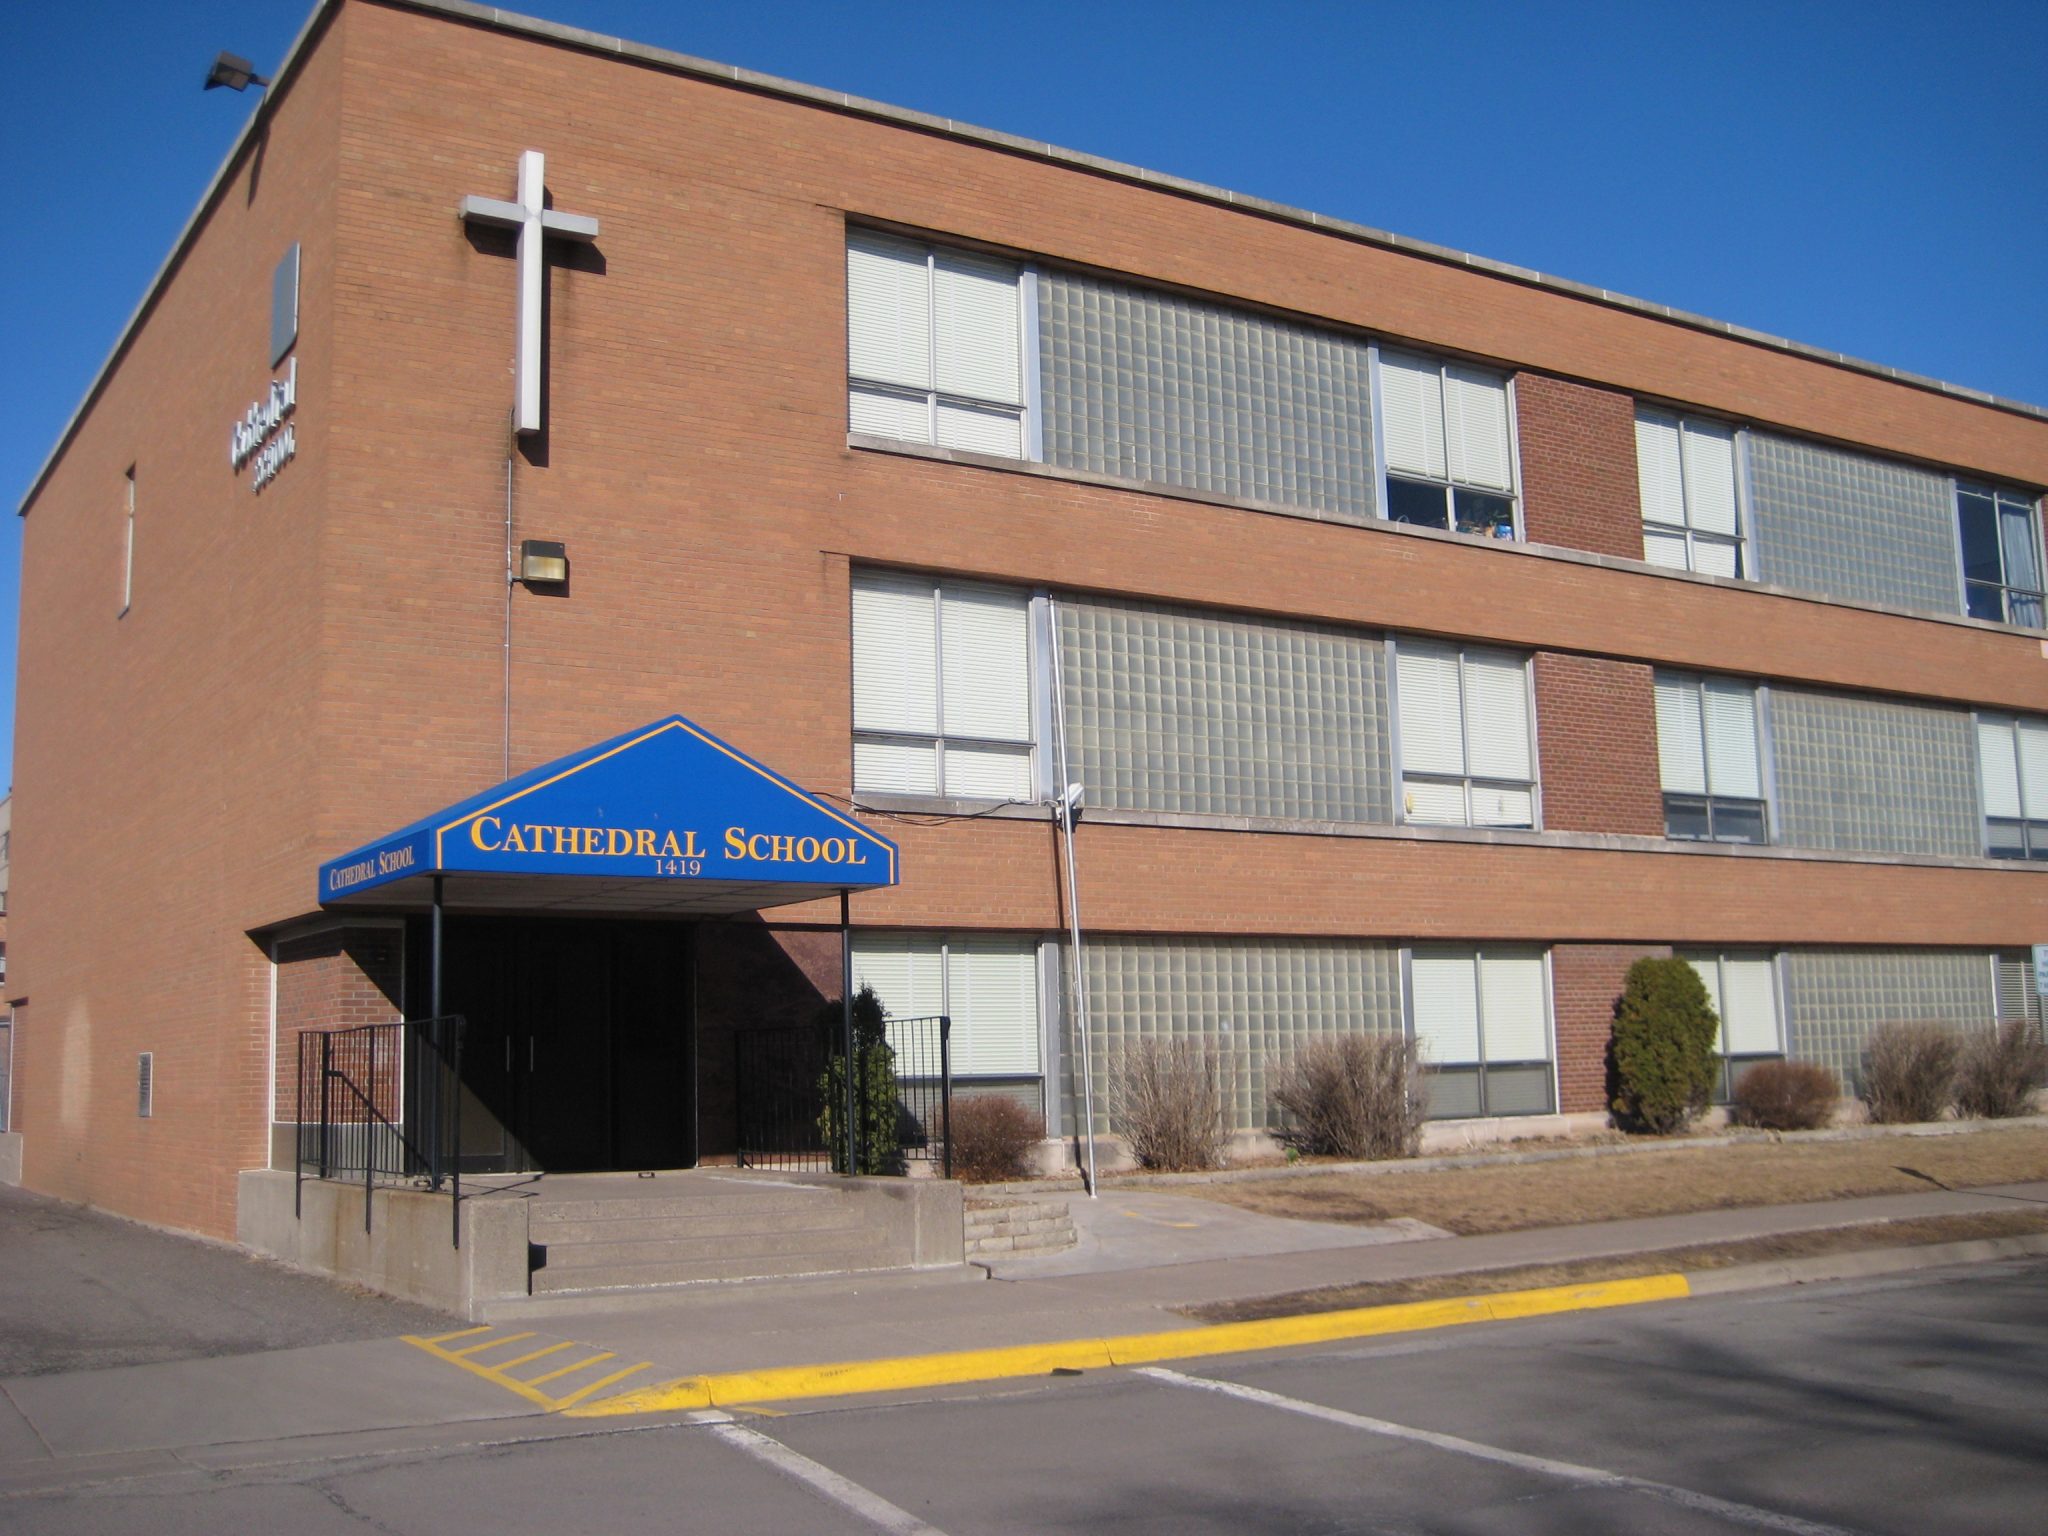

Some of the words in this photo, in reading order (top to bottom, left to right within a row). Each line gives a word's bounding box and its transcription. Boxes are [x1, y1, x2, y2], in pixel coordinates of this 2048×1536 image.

[470, 815, 706, 858] CATHEDRAL
[724, 826, 867, 865] SCHOOL
[330, 859, 376, 891] CATHEDRAL
[379, 845, 414, 875] SCHOOL
[655, 858, 701, 876] 1419
